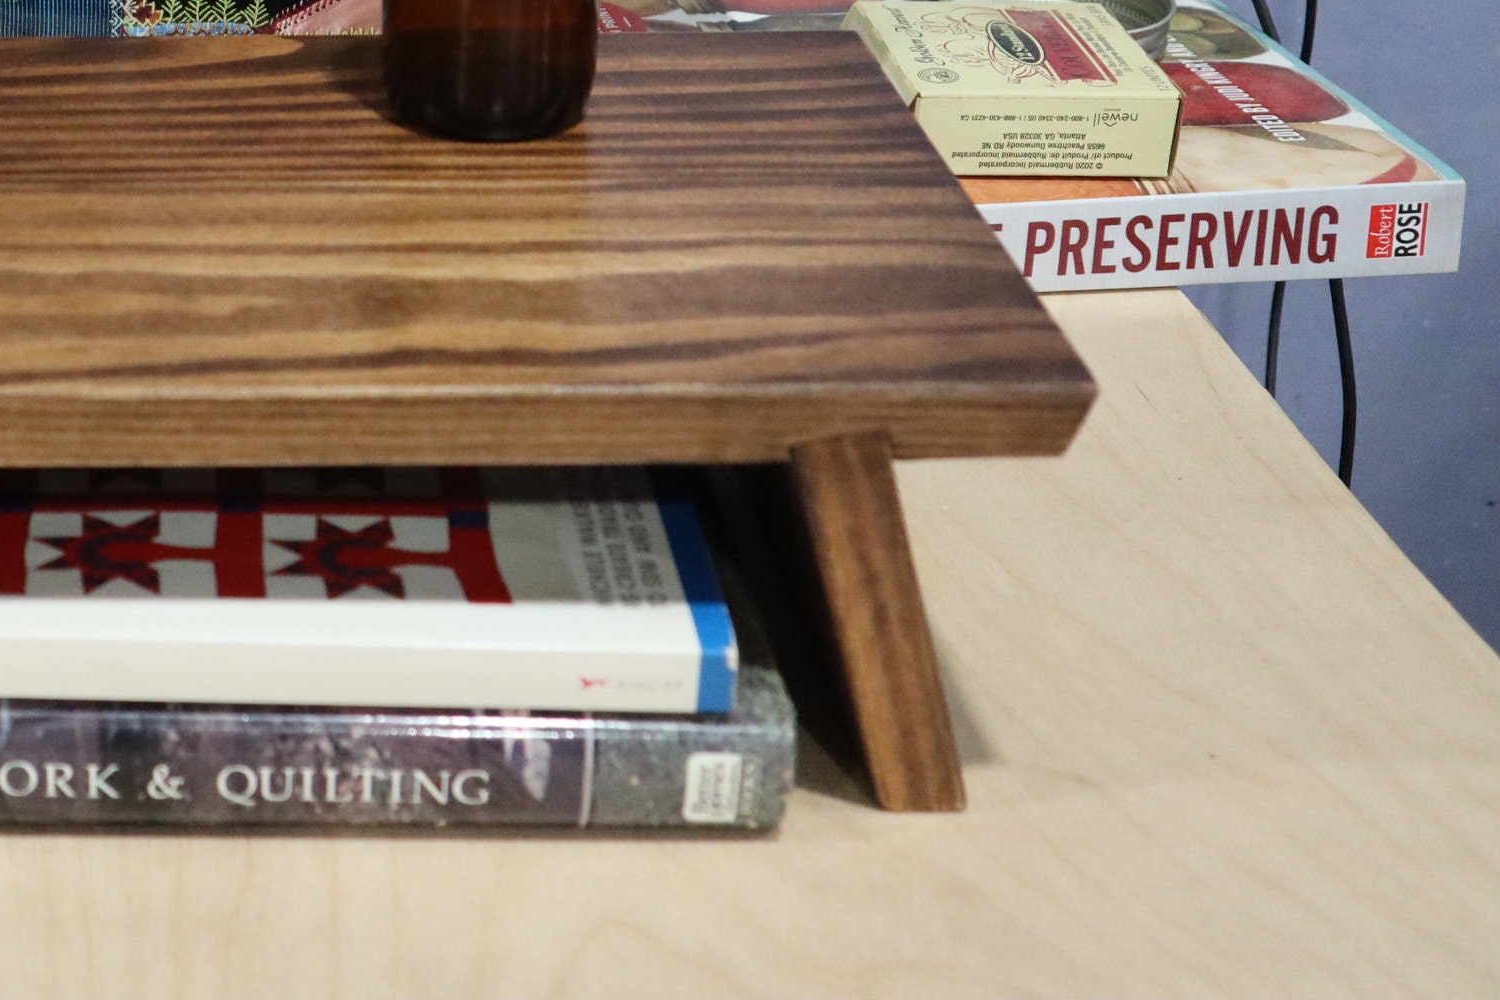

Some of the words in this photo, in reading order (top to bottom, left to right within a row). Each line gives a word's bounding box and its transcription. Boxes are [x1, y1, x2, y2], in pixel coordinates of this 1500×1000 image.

[996, 22, 1031, 55] Standard
[1016, 50, 1035, 61] 12
[1178, 59, 1232, 84] KINGRY
[1213, 85, 1255, 101] JUDI
[1235, 103, 1270, 113] BY
[1028, 114, 1037, 122] US
[1093, 111, 1139, 127] newell
[1251, 114, 1307, 142] EDITED
[1003, 132, 1018, 140] USA
[1020, 132, 1043, 140] 30328
[1057, 132, 1087, 140] Atlanta,
[1006, 141, 1046, 149] Dunwoody
[1048, 142, 1086, 150] Peachtree
[1087, 142, 1106, 150] 6655
[951, 150, 1001, 159] Incorporated
[1001, 151, 1047, 160] Rubbermaid
[1062, 152, 1090, 160] Produit
[1103, 152, 1133, 160] Product
[978, 160, 1027, 169] Incorporated
[1028, 161, 1074, 170] Rubbermaid
[1075, 162, 1094, 170] 2020
[1371, 205, 1395, 257] Robert
[1394, 202, 1423, 258] ROSE
[1023, 204, 1340, 278] PRESERVING
[146, 763, 186, 800] &
[216, 764, 492, 807] QUILTING
